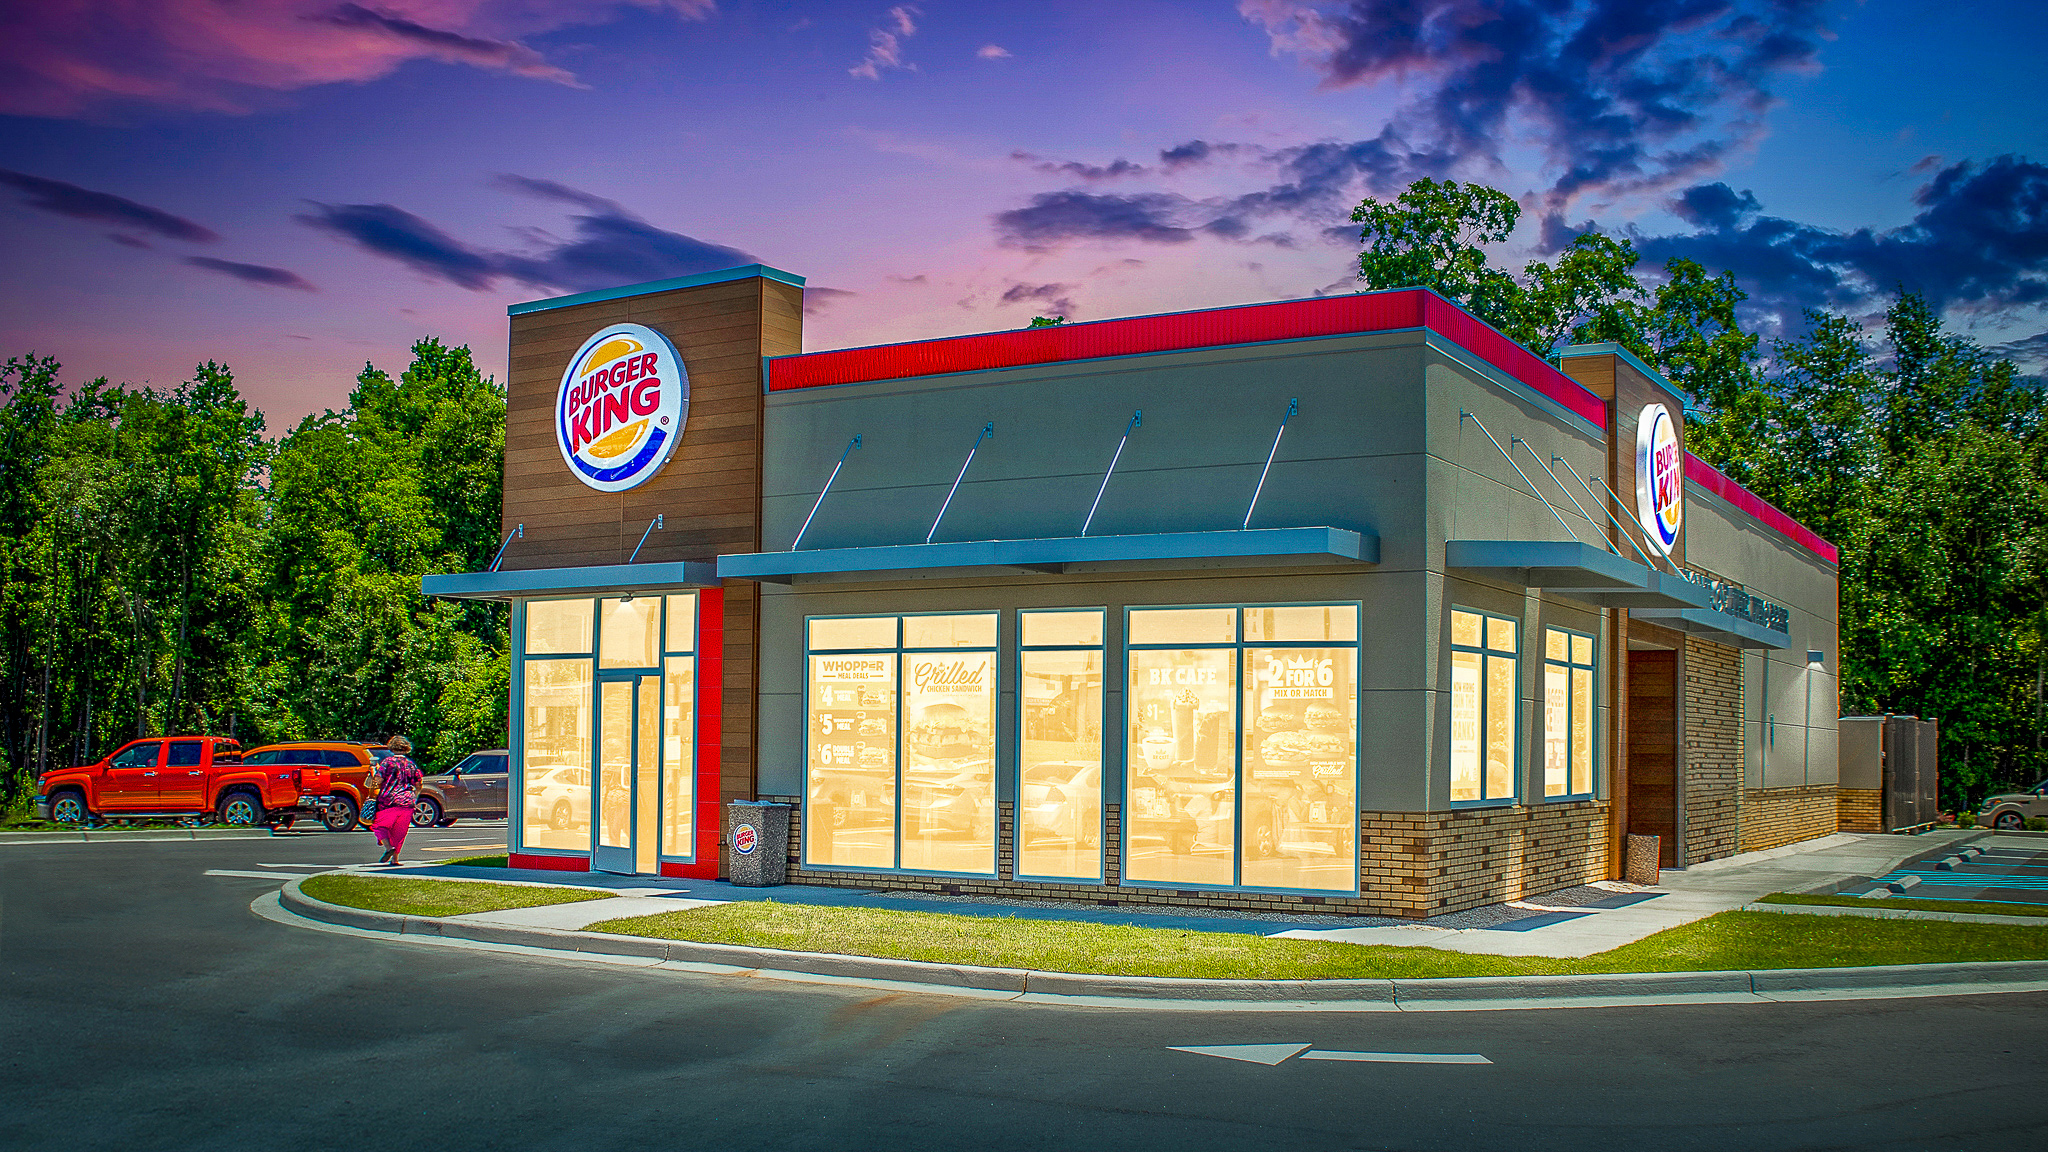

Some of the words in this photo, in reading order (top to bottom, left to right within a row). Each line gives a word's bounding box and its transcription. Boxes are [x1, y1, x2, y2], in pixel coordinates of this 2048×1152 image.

[569, 353, 658, 417] BURGER
[572, 377, 660, 454] KING
[1657, 466, 1680, 512] KIN
[822, 661, 884, 671] WHOPPER
[1150, 668, 1174, 685] BK
[914, 661, 986, 694] Grilled
[1286, 669, 1315, 687] FOR
[820, 685, 834, 707] $4
[926, 685, 950, 693] CHICKEN
[951, 685, 982, 693] SANDWICH
[1274, 689, 1288, 697] MIX
[1290, 689, 1301, 697] OR
[1303, 689, 1327, 697] MATCH
[819, 713, 833, 735] $5
[817, 743, 832, 765] $6
